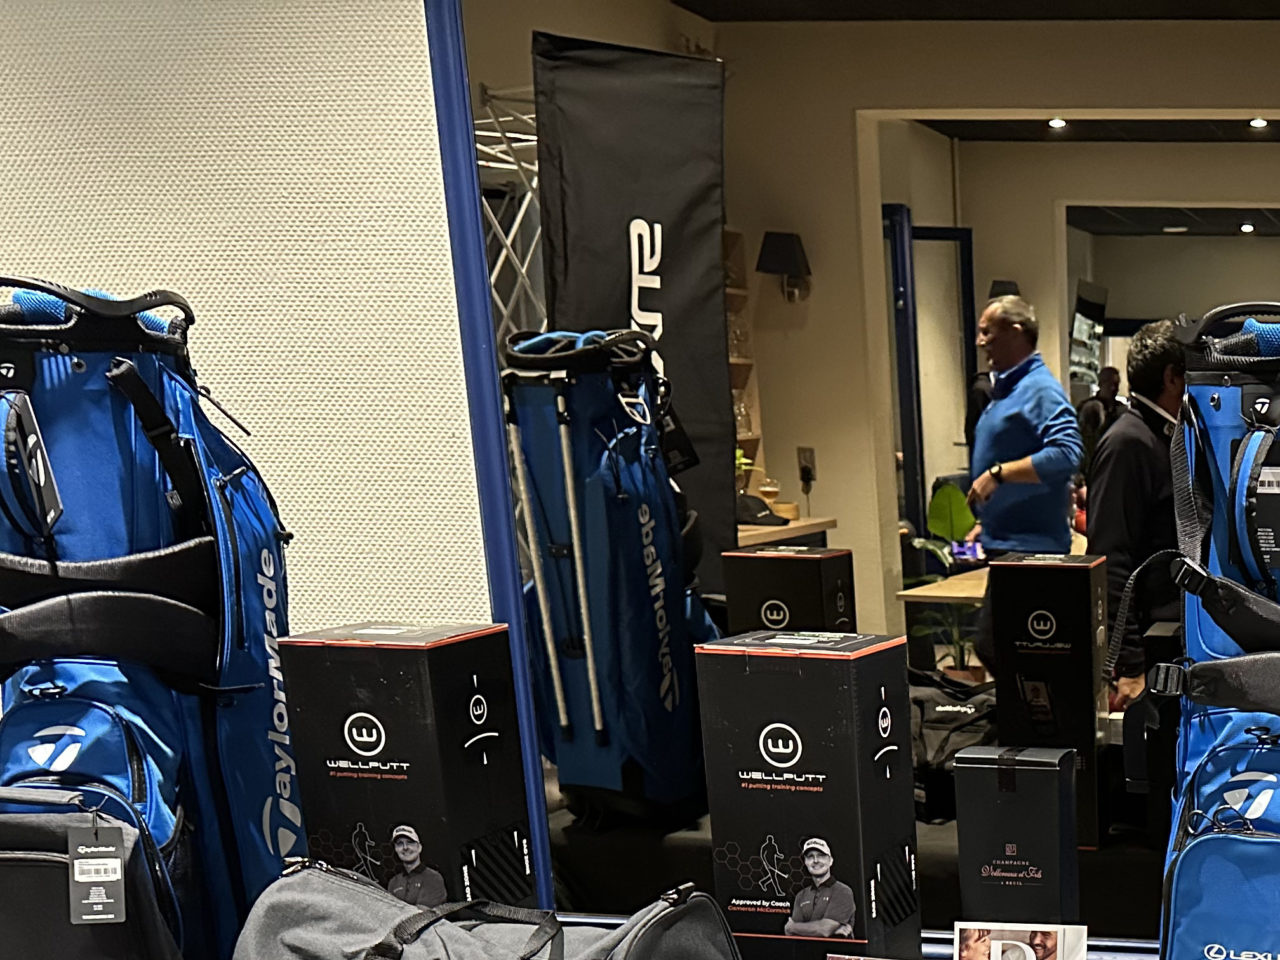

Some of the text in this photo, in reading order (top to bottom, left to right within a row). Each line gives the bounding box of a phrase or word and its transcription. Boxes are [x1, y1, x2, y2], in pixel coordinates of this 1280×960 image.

[257, 547, 302, 858] TaylorMade
[326, 760, 410, 770] WELLPUTT
[738, 771, 827, 782] WELLPUTT
[749, 783, 771, 791] putting
[731, 899, 761, 907] Approved
